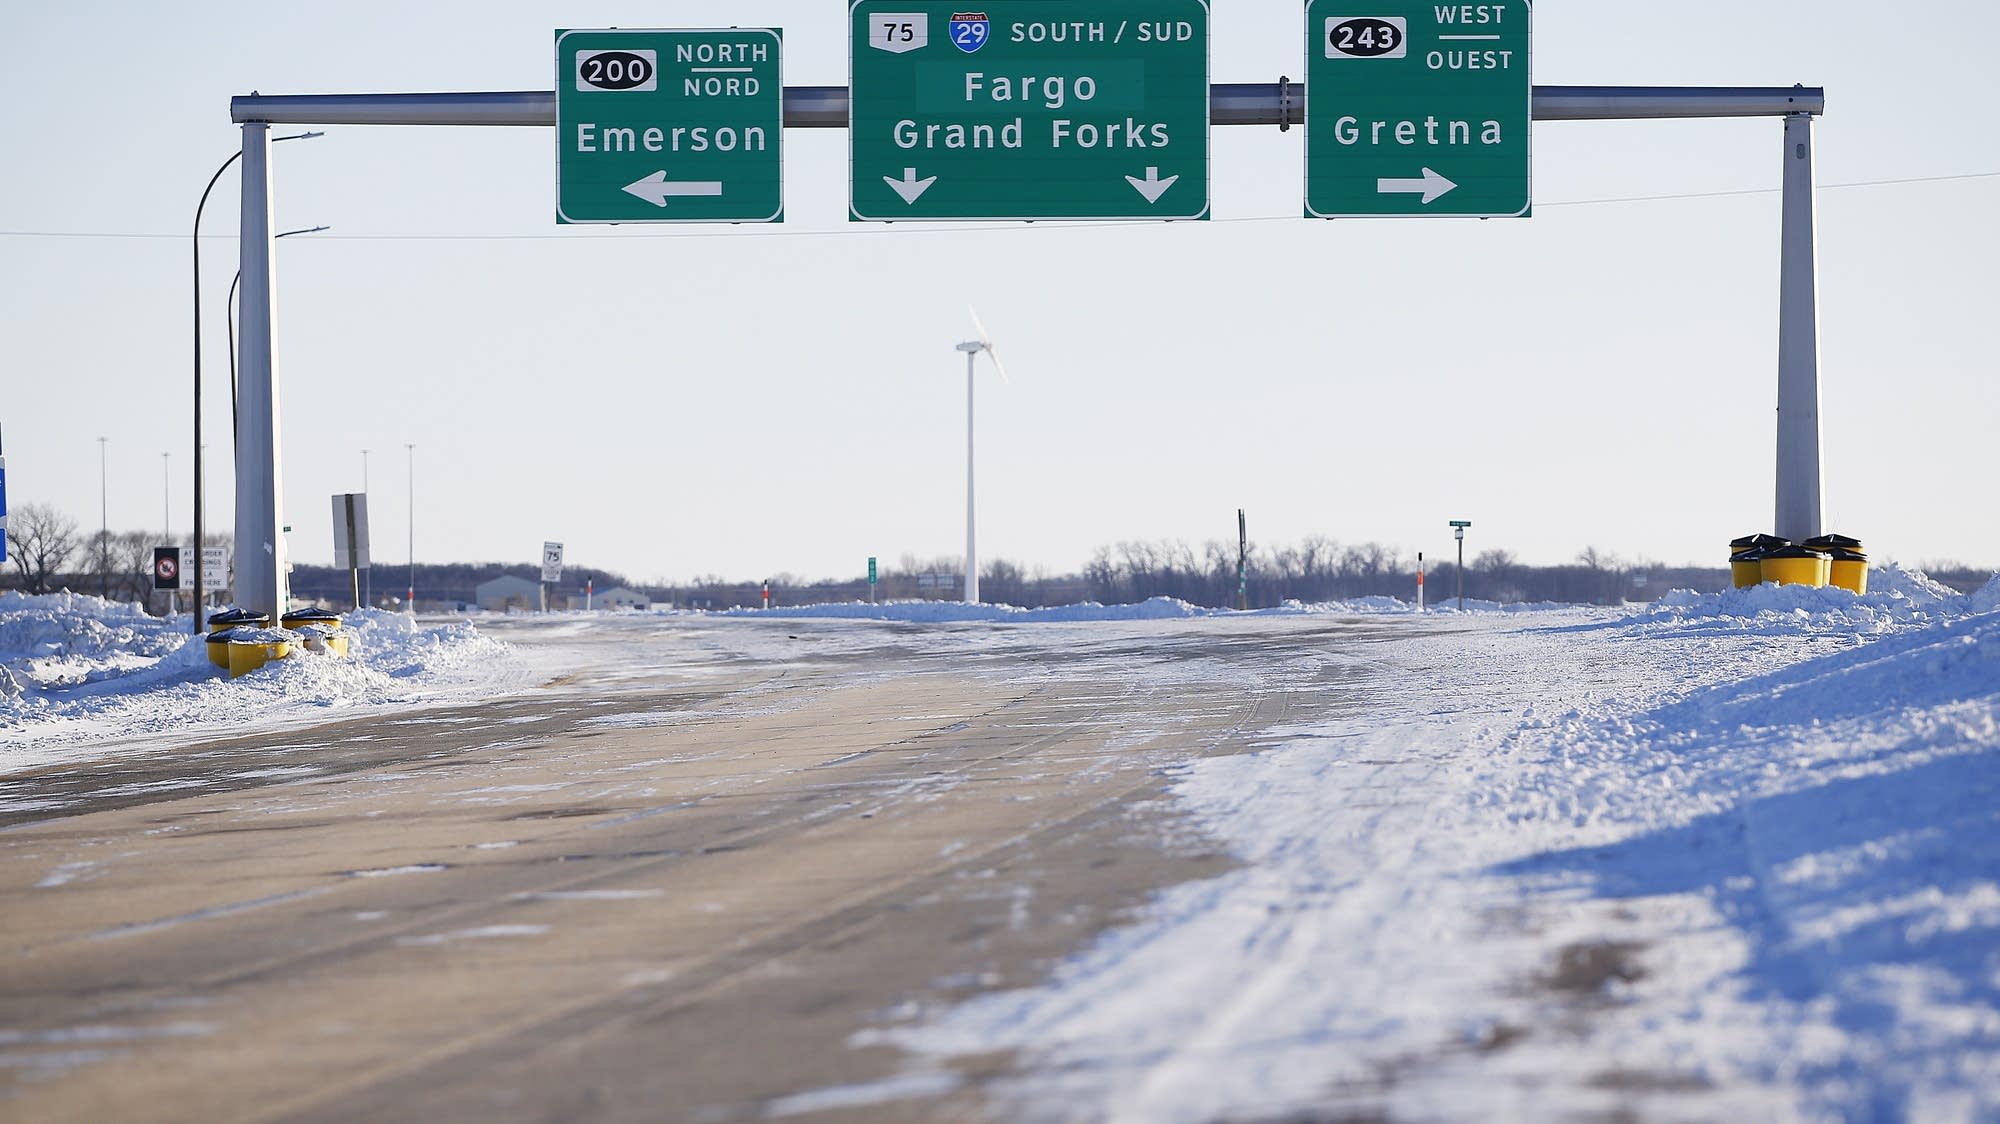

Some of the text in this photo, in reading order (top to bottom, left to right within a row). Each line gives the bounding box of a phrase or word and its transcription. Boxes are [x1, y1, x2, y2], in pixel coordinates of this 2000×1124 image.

[1434, 5, 1506, 24] WEST
[883, 23, 914, 42] 75
[956, 22, 986, 44] 29
[1011, 20, 1192, 44] SOUTH / SUD
[1338, 26, 1394, 49] 243
[677, 43, 767, 63] NORTH
[1426, 50, 1513, 70] OUEST
[587, 59, 645, 82] 200
[684, 77, 760, 96] NORD
[965, 72, 1096, 109] Fargo
[577, 123, 765, 152] Emerson
[893, 117, 1169, 149] Grand Forks
[1334, 115, 1502, 145] Gretna
[546, 551, 560, 562] 75
